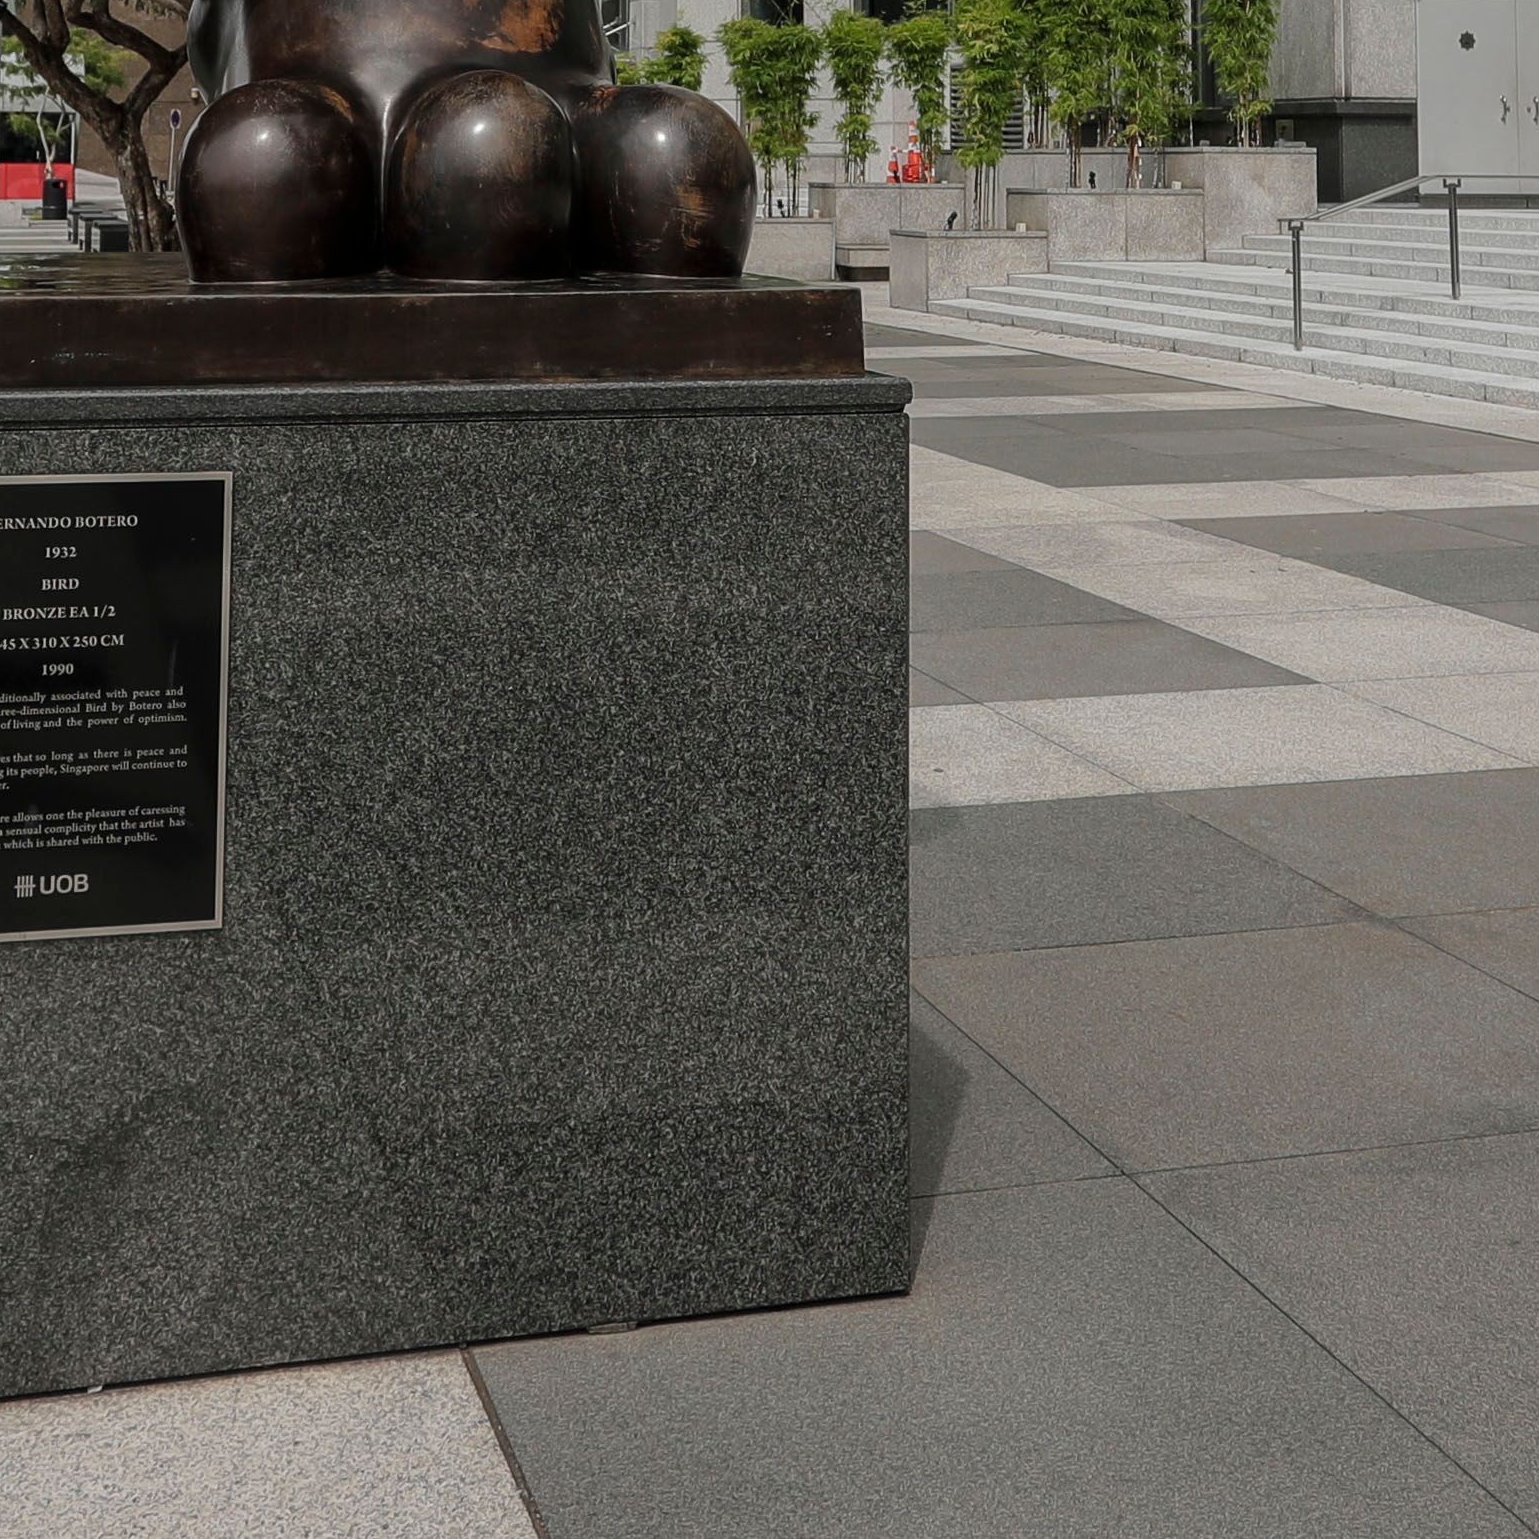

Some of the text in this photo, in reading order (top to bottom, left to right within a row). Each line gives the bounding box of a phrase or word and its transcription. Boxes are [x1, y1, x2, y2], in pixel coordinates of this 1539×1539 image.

[74, 514, 138, 529] BOTERO
[44, 546, 77, 559] 1932
[41, 578, 80, 591] BIRD
[2, 605, 116, 621] BRONZE EA 1/2
[19, 637, 31, 650] X
[32, 637, 57, 649] 310
[60, 636, 71, 648] X
[73, 635, 98, 648] 250
[100, 634, 125, 647] CM
[41, 663, 74, 677] 1990
[50, 690, 101, 701] associated
[105, 689, 128, 698] with
[132, 689, 160, 699] peace
[165, 686, 183, 696] and
[86, 702, 106, 712] Bird
[111, 701, 124, 713] by
[129, 700, 162, 711] Botero
[167, 699, 186, 709] also
[0, 719, 13, 730] of
[13, 718, 41, 731] living
[43, 718, 61, 728] and
[66, 716, 83, 727] the
[87, 716, 118, 729] power
[123, 714, 135, 724] of
[138, 714, 187, 725] optimism.
[12, 752, 33, 763] that
[35, 753, 46, 762] so
[51, 751, 74, 762] long
[78, 751, 89, 760] as
[93, 749, 119, 760] there
[124, 748, 132, 758] is
[137, 748, 165, 759] peace
[169, 745, 187, 755] and
[6, 767, 19, 777] its
[20, 764, 58, 778] people,
[60, 763, 109, 775] Singapore
[111, 761, 130, 771] will
[131, 760, 175, 770] continue
[177, 759, 187, 769] to
[12, 811, 43, 823] allows
[45, 811, 65, 821] one
[67, 809, 83, 820] the
[85, 808, 126, 820] pleasure
[128, 806, 140, 816] of
[141, 804, 186, 817] caressing
[5, 825, 42, 836] sensual
[44, 822, 97, 835] complicity
[98, 821, 119, 832] that
[121, 820, 137, 830] the
[139, 818, 164, 829] artist
[168, 817, 186, 827] has
[3, 839, 34, 849] which
[35, 838, 45, 847] is
[46, 836, 80, 847] shared
[81, 834, 104, 845] with
[106, 833, 122, 843] the
[124, 832, 158, 845] public.
[39, 873, 89, 895] UOB
